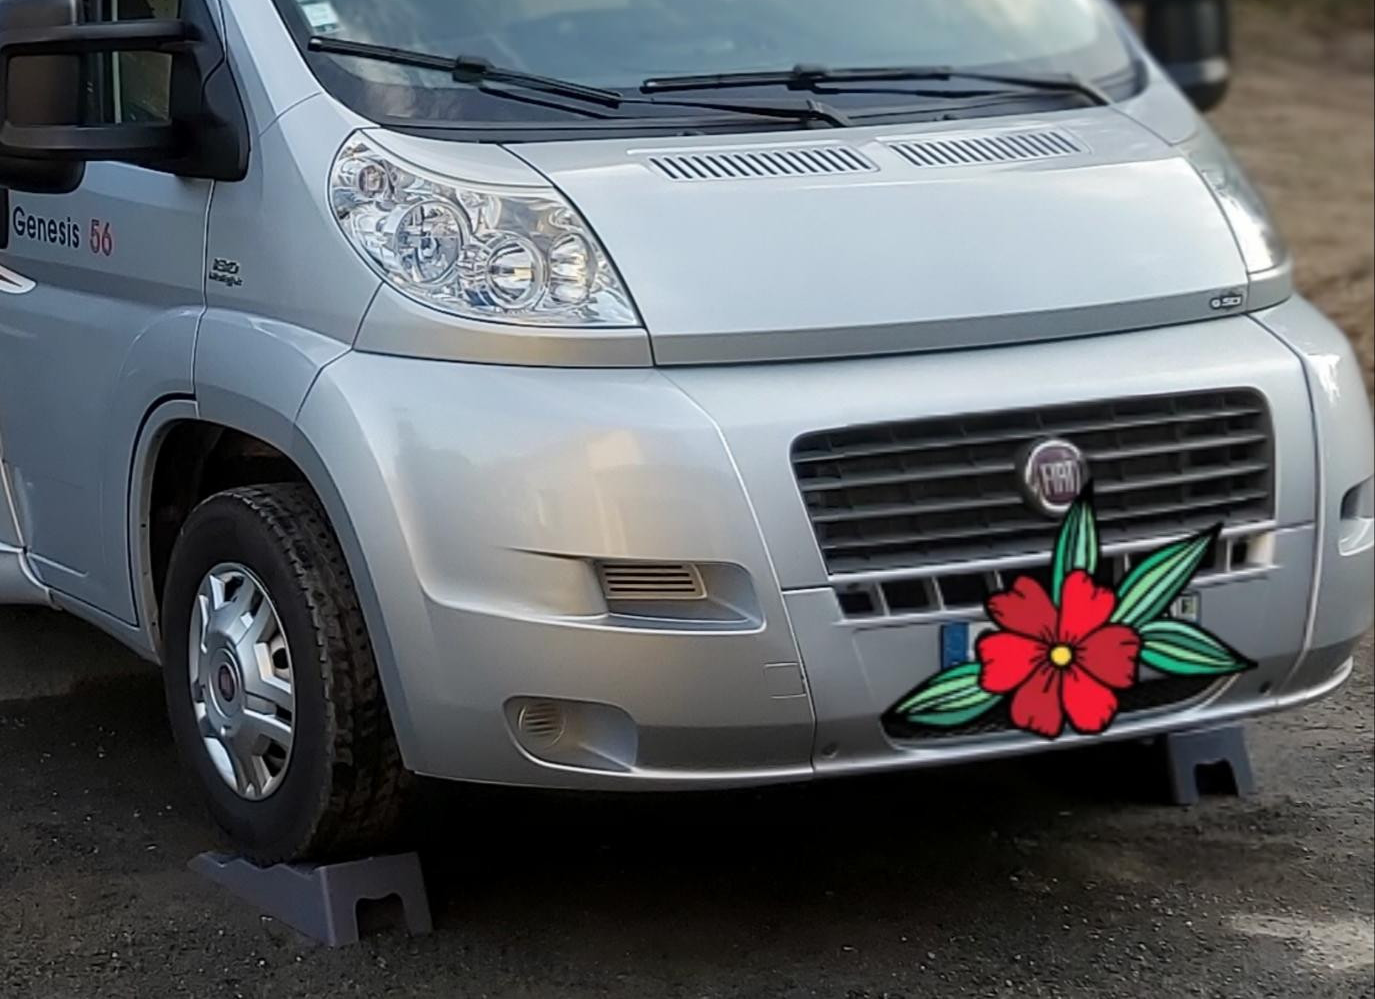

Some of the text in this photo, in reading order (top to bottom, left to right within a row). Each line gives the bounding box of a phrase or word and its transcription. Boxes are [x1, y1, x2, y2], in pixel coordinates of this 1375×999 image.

[12, 205, 114, 258] Genesis 56
[1039, 459, 1081, 496] FIAT
